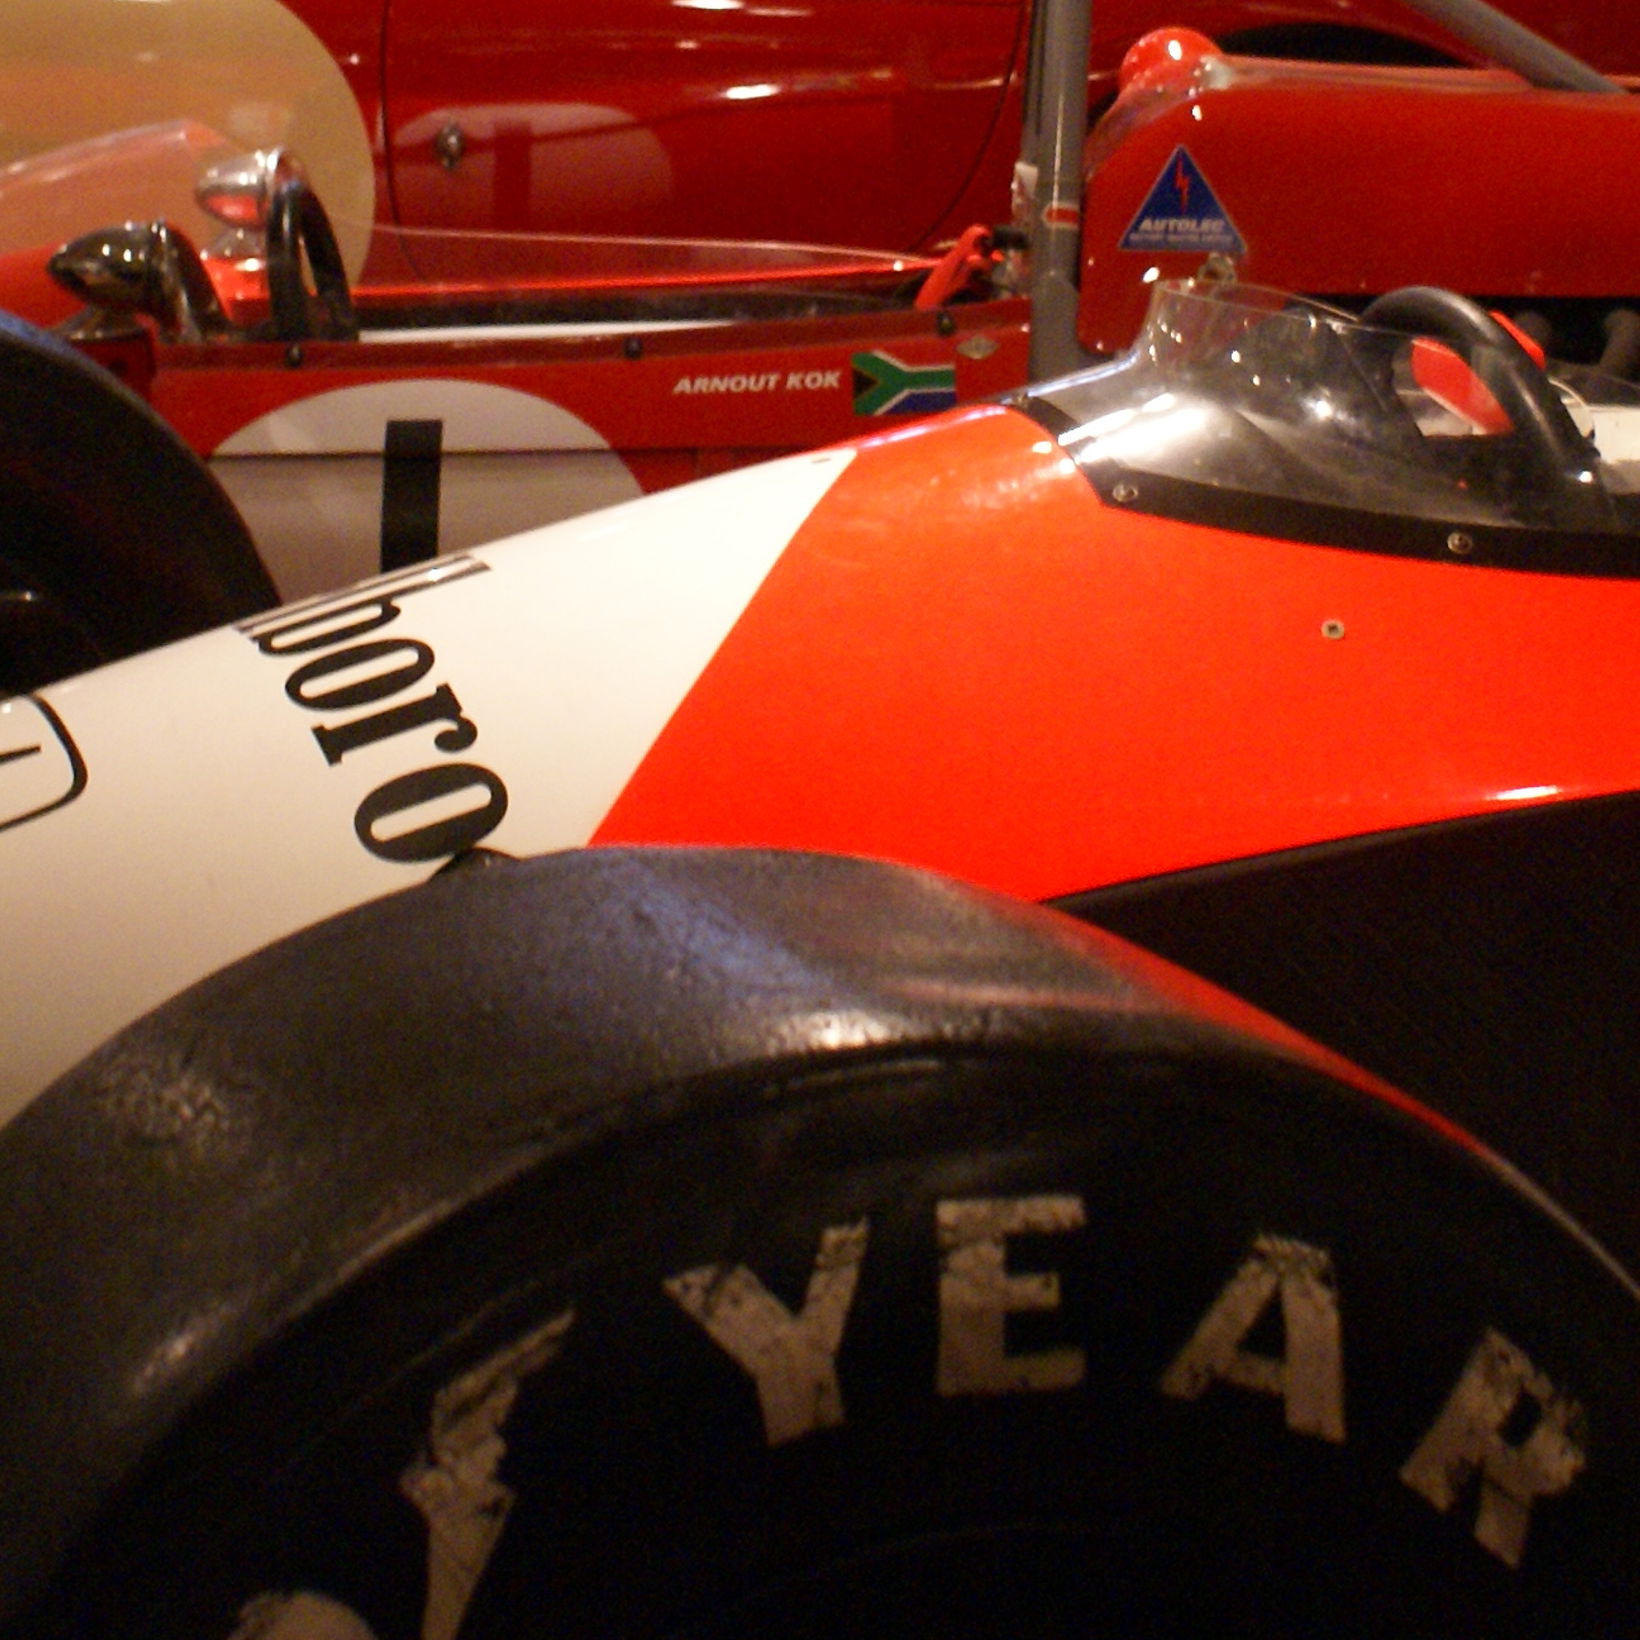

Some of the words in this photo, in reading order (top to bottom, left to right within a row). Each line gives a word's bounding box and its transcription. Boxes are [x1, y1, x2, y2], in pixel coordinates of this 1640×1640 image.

[672, 373, 781, 395] ARNOUT
[785, 370, 842, 391] KOK
[661, 1192, 1588, 1571] YEAR
